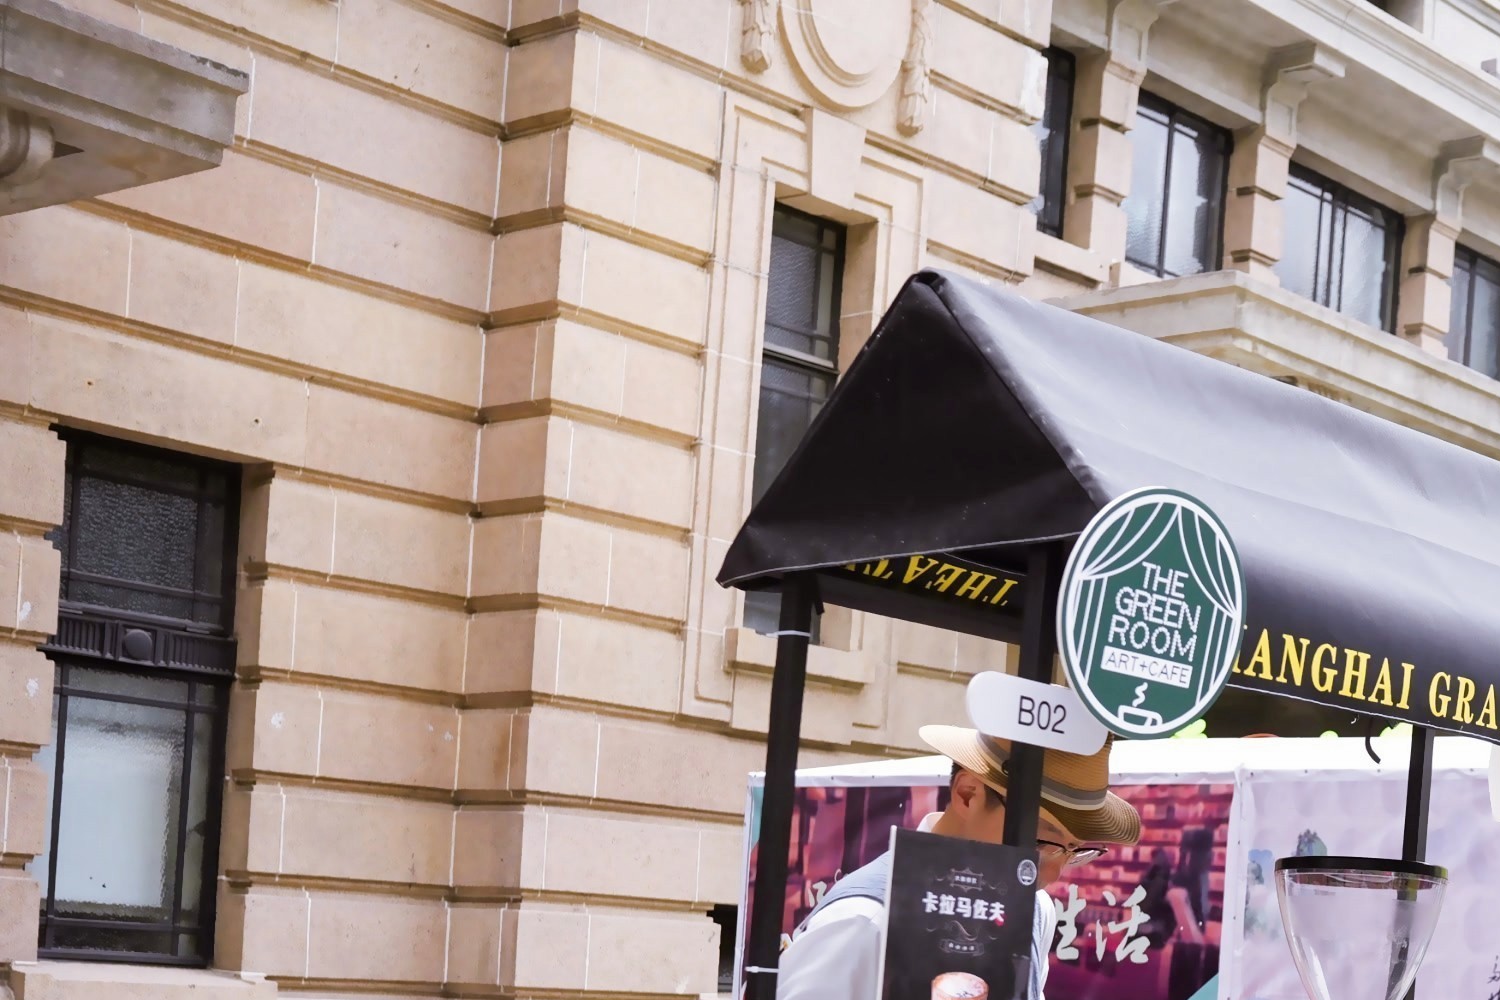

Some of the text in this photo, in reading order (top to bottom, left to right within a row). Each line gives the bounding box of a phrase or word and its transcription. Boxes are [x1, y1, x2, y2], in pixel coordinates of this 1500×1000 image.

[842, 554, 1019, 607] THEAT
[1142, 561, 1189, 599] THE
[1115, 586, 1201, 633] GREEN
[1107, 614, 1197, 662] ROOM
[1105, 651, 1190, 685] ART+CAFE
[1232, 624, 1415, 709] ANGHAI
[1018, 695, 1067, 735] B02
[922, 891, 1005, 922] 卡拉马佐夫
[1054, 884, 1152, 964] 生活
